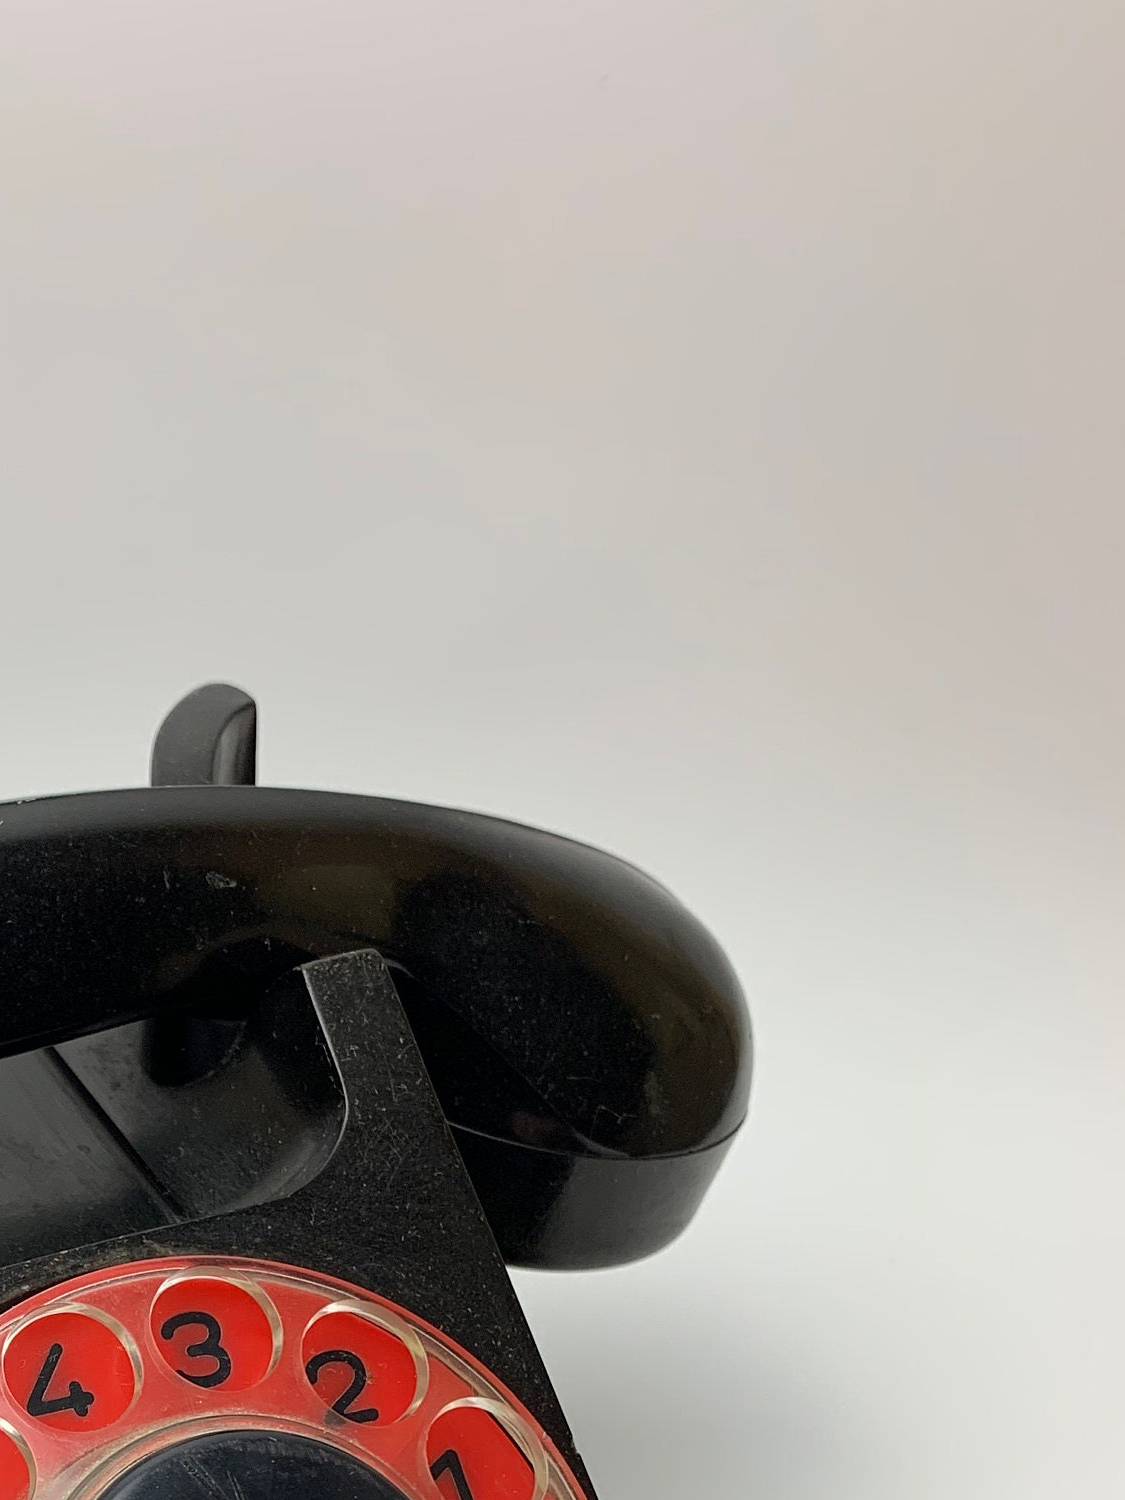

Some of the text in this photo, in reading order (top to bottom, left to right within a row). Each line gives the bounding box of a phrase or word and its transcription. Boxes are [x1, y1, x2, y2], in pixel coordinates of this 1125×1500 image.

[26, 1343, 95, 1417] 4
[161, 1311, 232, 1388] 3
[305, 1350, 379, 1424] 2
